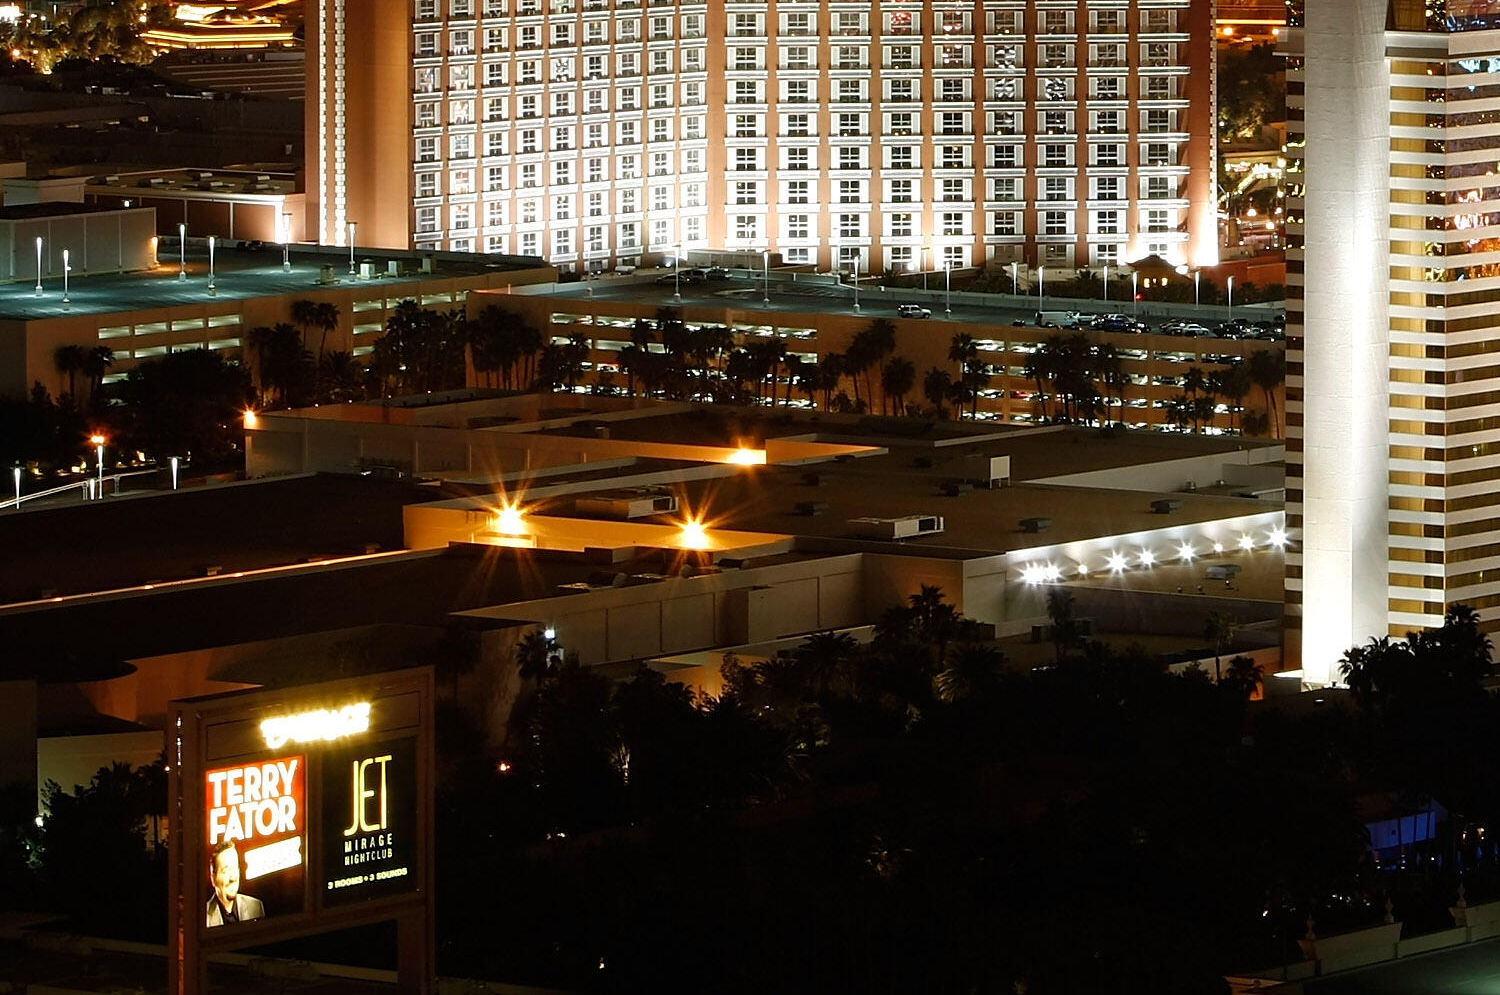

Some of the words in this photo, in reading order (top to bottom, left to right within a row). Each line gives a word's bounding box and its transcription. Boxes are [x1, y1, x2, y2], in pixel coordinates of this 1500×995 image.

[208, 759, 298, 807] TERRY
[344, 755, 393, 836] JET
[209, 796, 296, 845] FATOR
[344, 833, 393, 853] MIRAGE
[344, 848, 393, 866] NIGHTCLUB
